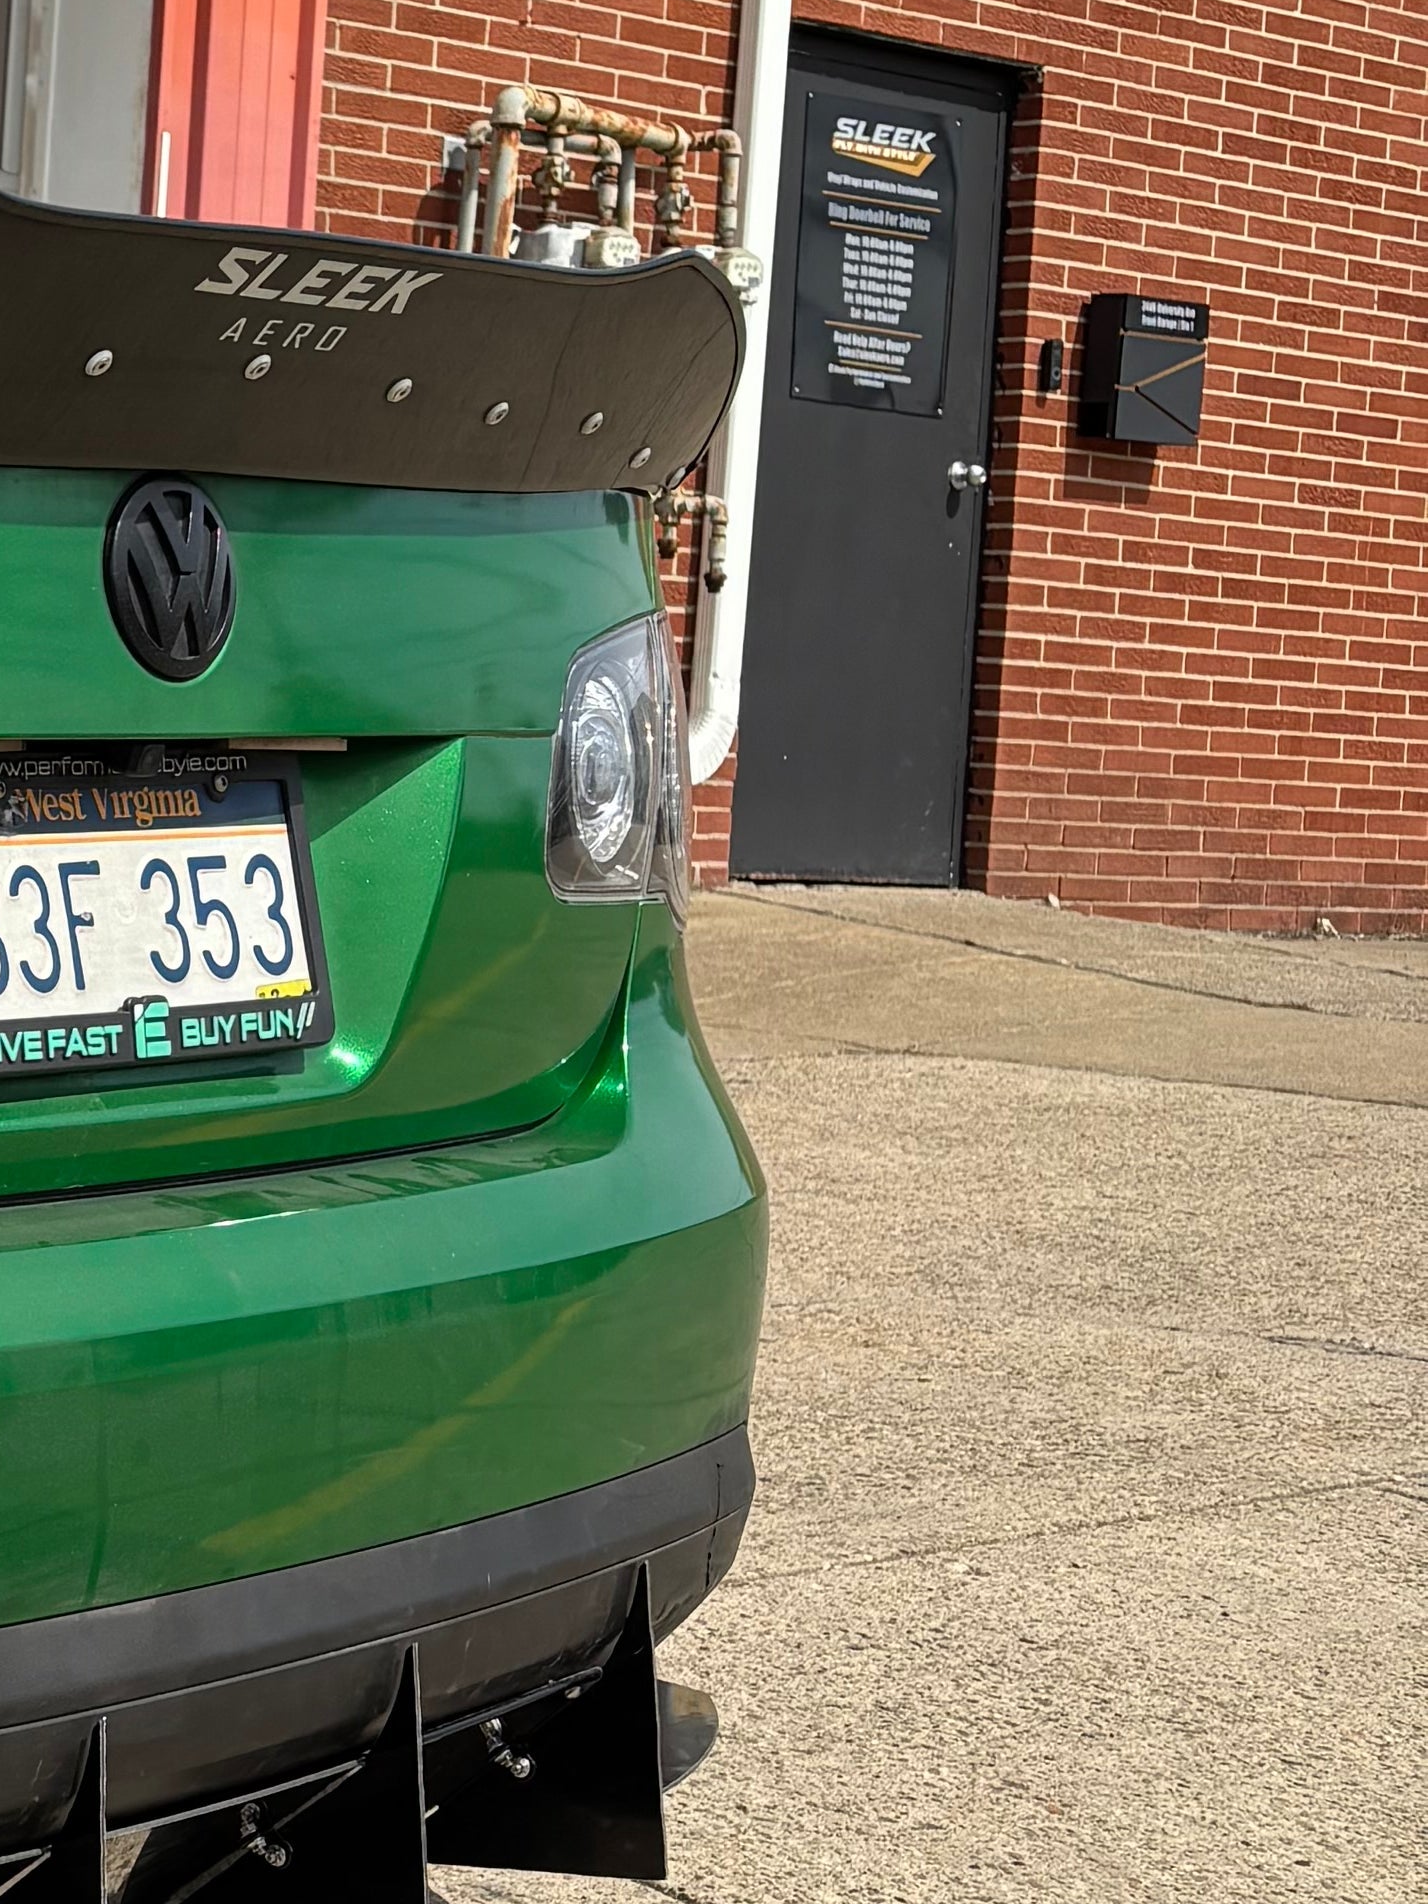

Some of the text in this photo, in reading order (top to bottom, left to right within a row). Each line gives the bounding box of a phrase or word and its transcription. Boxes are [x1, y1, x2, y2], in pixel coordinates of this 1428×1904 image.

[833, 117, 937, 153] SLEEK
[194, 247, 444, 314] SLEEK
[219, 317, 348, 351] AERO
[12, 786, 202, 828] West Virginia
[140, 853, 293, 983] 353
[48, 1025, 124, 1058] FAST
[181, 1015, 238, 1048] BUY
